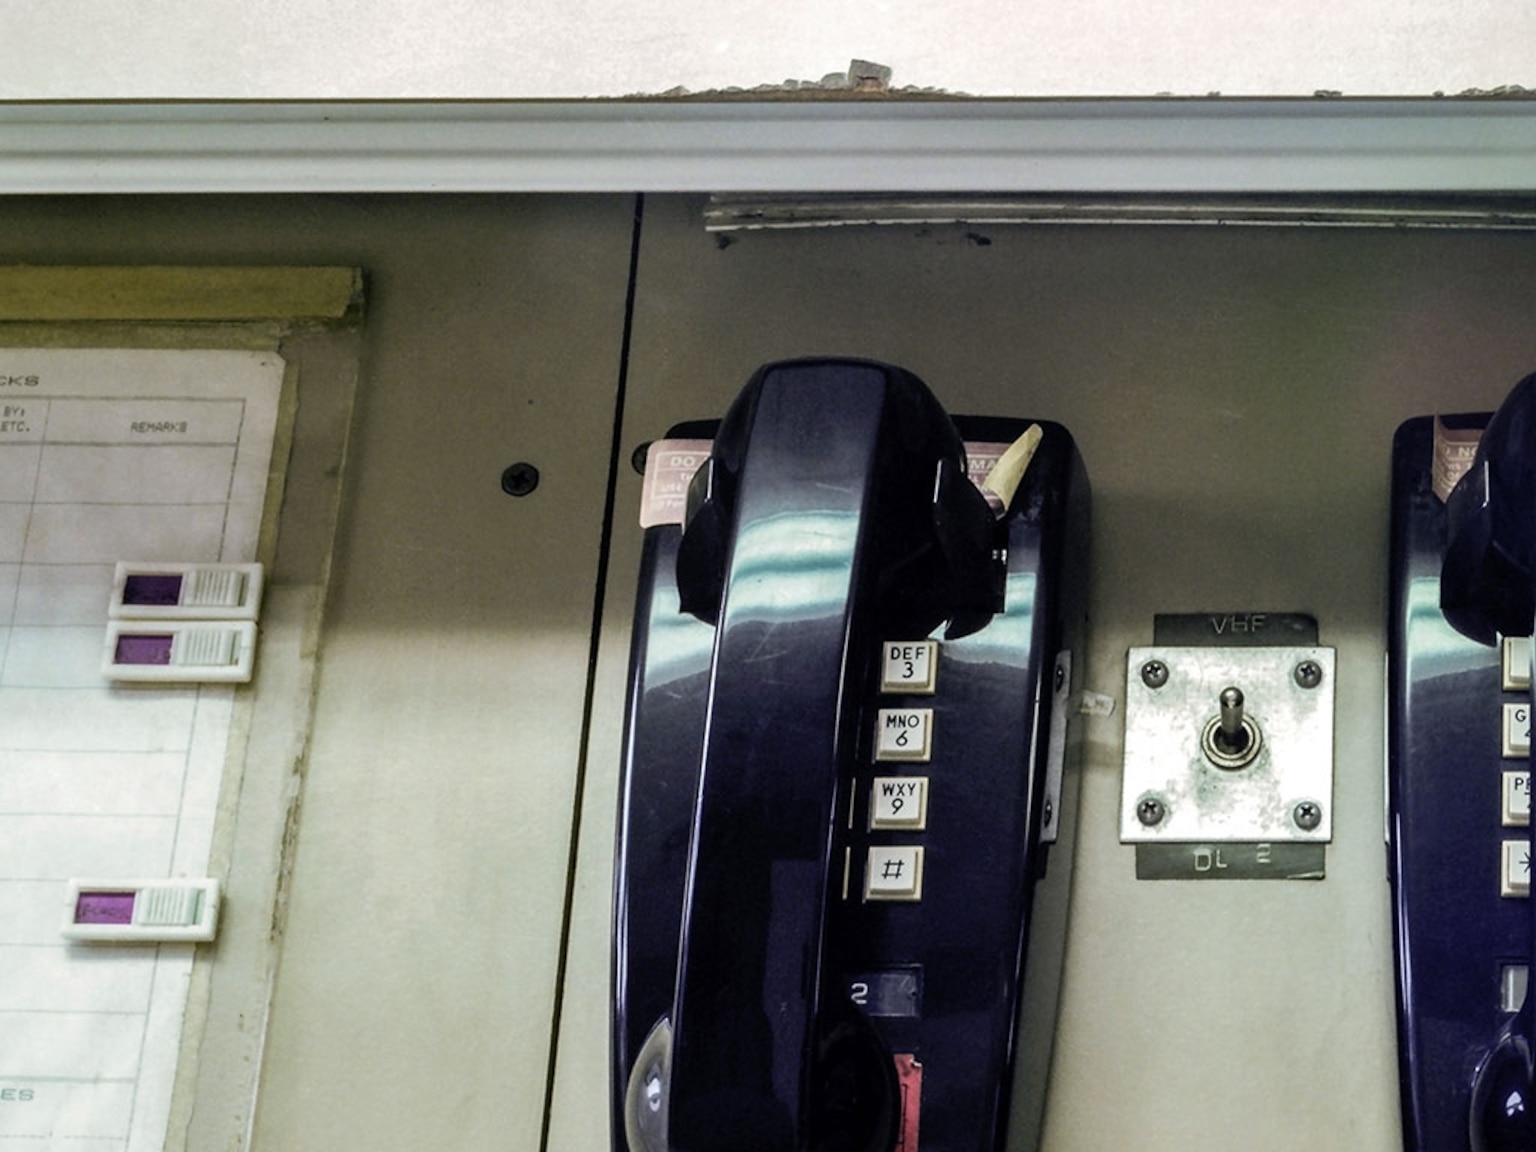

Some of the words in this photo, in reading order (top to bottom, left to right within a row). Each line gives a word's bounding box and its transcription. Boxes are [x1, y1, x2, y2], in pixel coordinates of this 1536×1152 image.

[130, 421, 188, 433] REMARKS
[670, 455, 696, 468] DO
[1212, 615, 1267, 635] VHF
[890, 646, 926, 661] DEF
[902, 662, 915, 679] 3
[886, 714, 920, 729] MNO
[895, 730, 909, 747] 6
[881, 783, 917, 797] WXY
[891, 798, 904, 815] 9
[1256, 843, 1271, 863] 2
[850, 983, 869, 1005] 2
